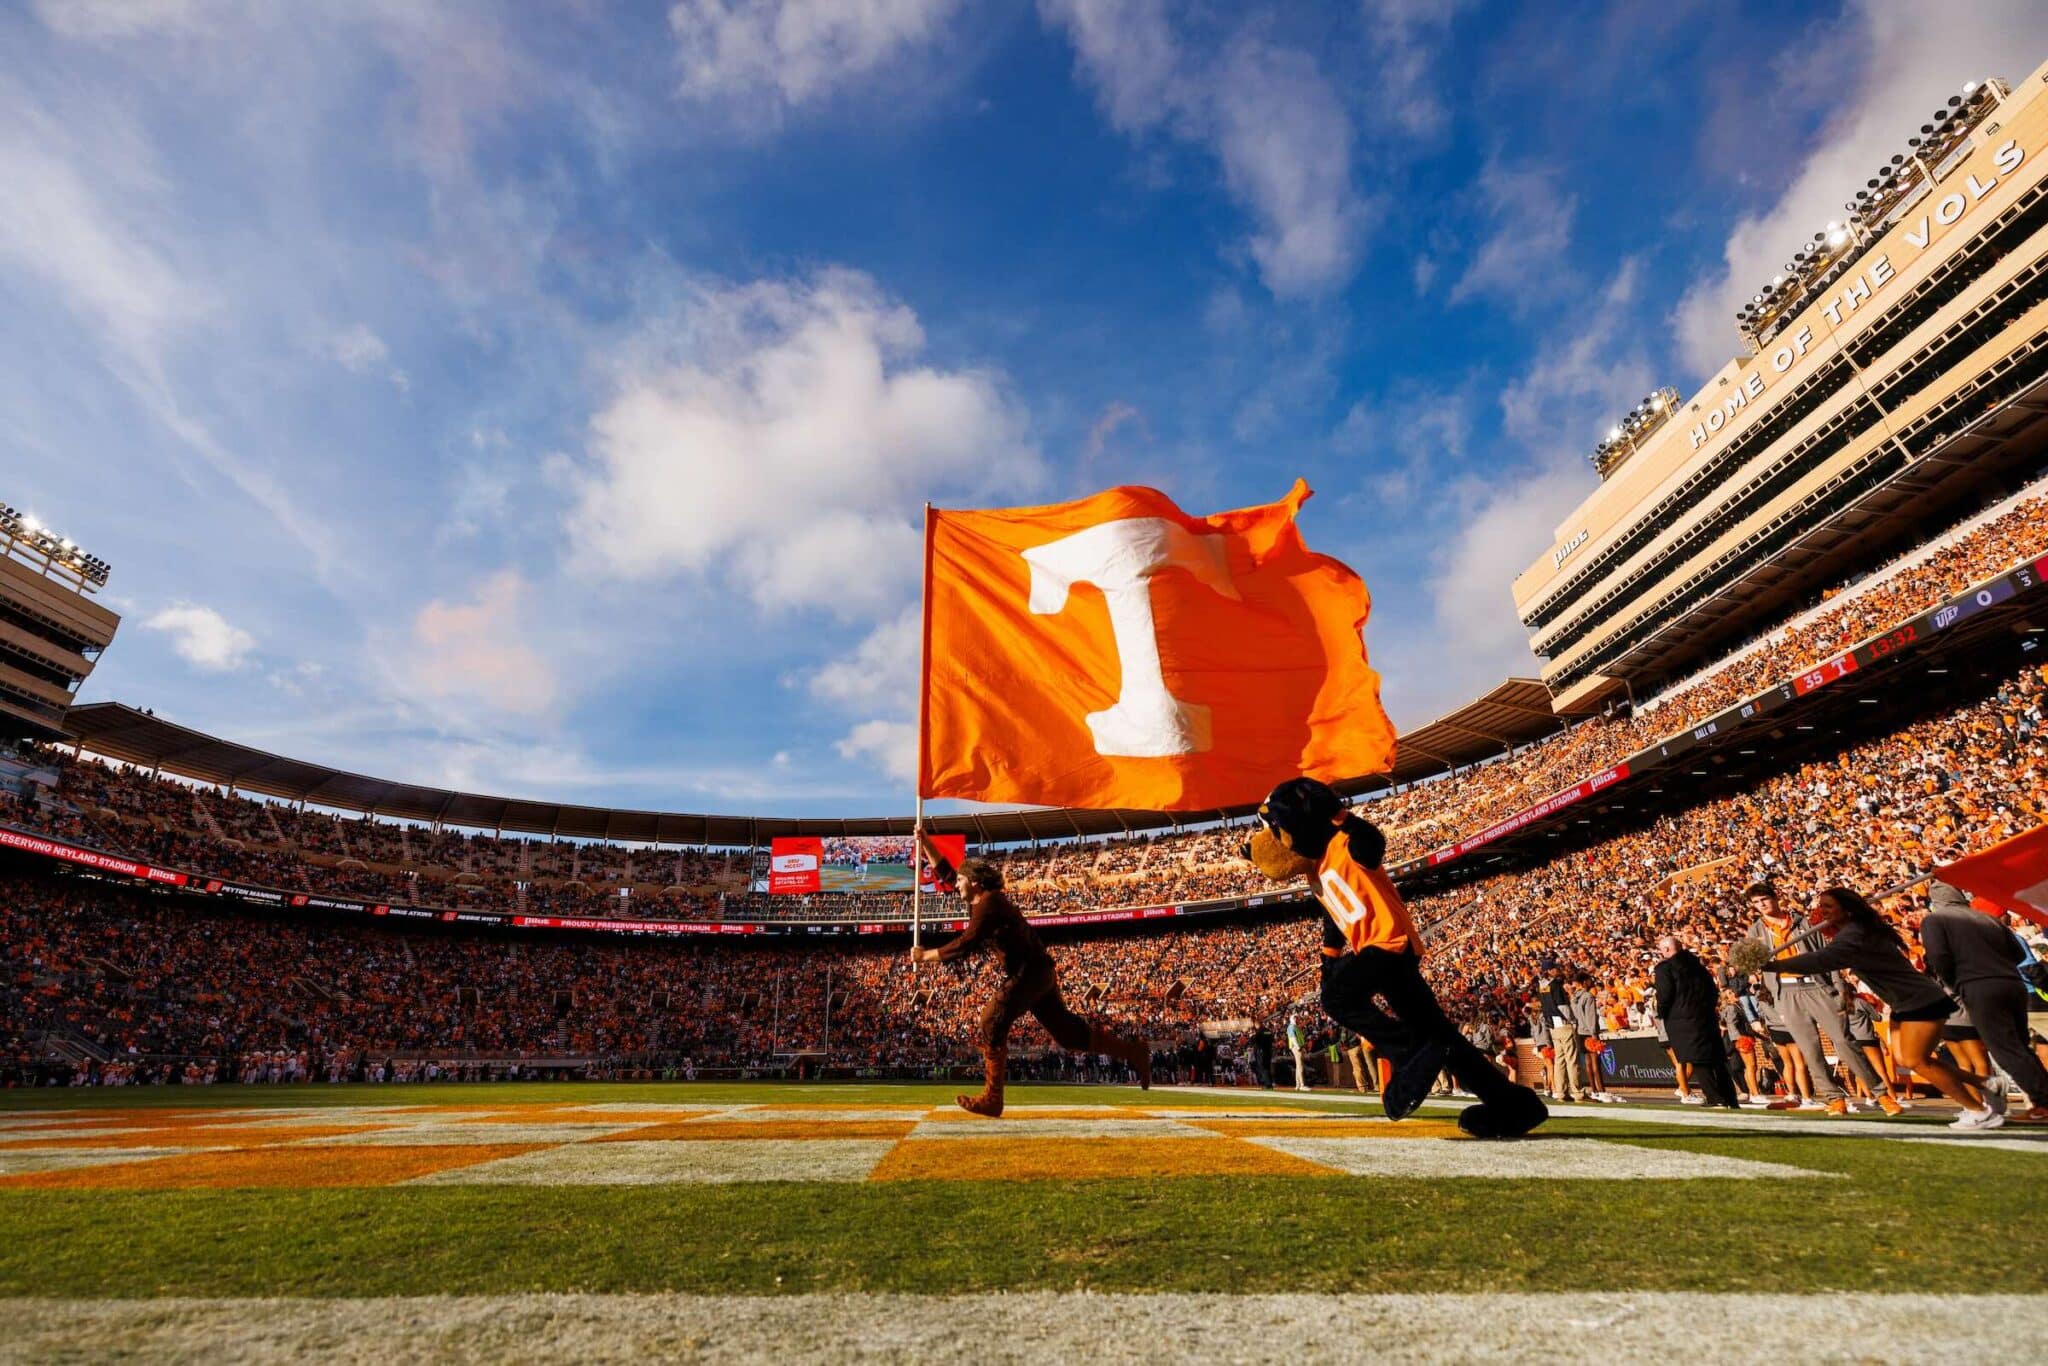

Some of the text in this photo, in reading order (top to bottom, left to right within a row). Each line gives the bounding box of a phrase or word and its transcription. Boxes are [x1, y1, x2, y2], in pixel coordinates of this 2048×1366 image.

[1688, 139, 2025, 450] HOME OF THE VOLS
[2021, 575, 2032, 587] 3
[1020, 516, 1243, 758] T
[1867, 625, 1919, 659] 13:32
[1803, 671, 1824, 690] 35
[1783, 690, 1791, 700] 3
[1460, 834, 1485, 852] PROUDLY
[1484, 815, 1519, 842] PRESERVING
[1518, 802, 1550, 825] NEYLAND
[1549, 788, 1582, 811] STADIUM
[0, 832, 52, 852] ESERVING
[52, 846, 98, 865] NEYLAND
[98, 857, 137, 874] STADIUM
[560, 920, 595, 928] PROUDLY
[597, 922, 644, 930] PRESERVING
[644, 924, 678, 932] NEYLAND
[679, 925, 711, 933] STADIUM
[1069, 914, 1101, 923] NEYLAND
[1102, 912, 1134, 920] STADIUM
[1620, 1064, 1678, 1079] of Tennesse
